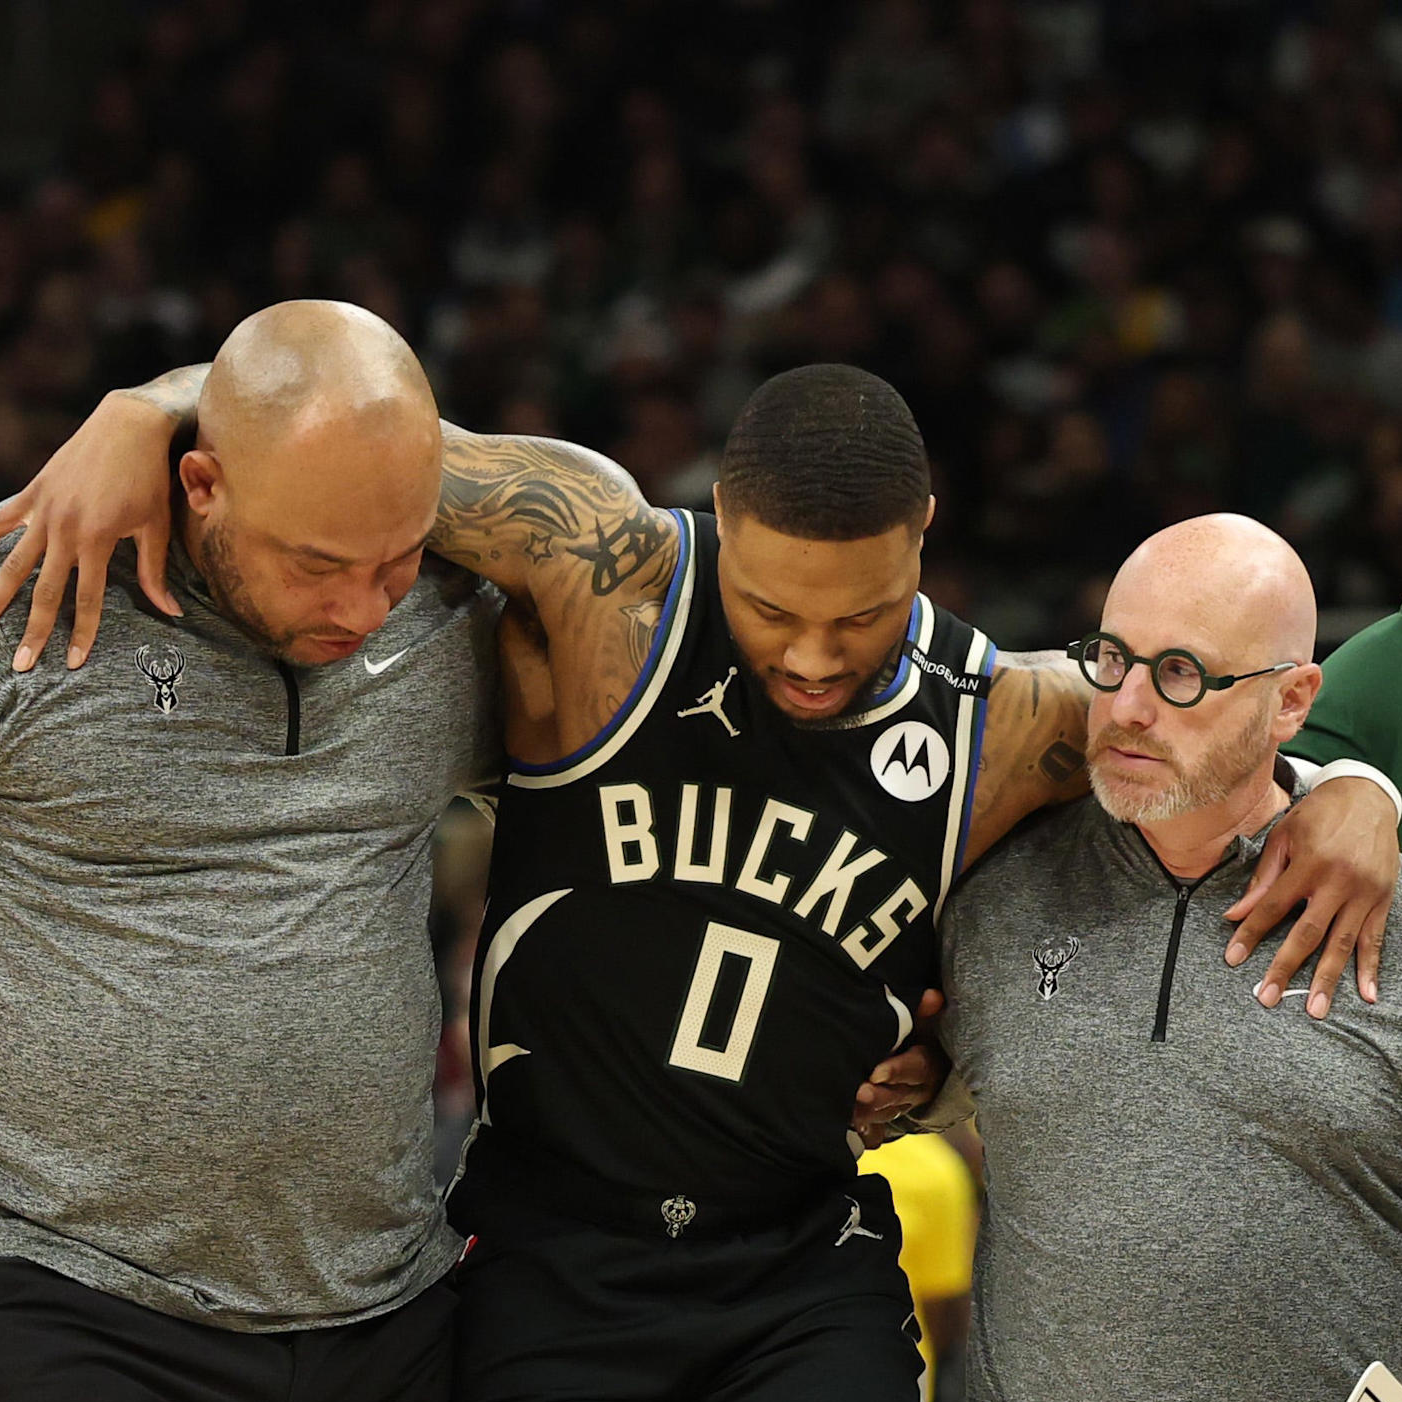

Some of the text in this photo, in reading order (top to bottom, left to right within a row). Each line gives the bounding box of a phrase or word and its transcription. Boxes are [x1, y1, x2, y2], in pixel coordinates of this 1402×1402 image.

[911, 648, 979, 691] BRIDGEMAN
[598, 782, 929, 971] BUCKS
[668, 921, 780, 1083] 0
